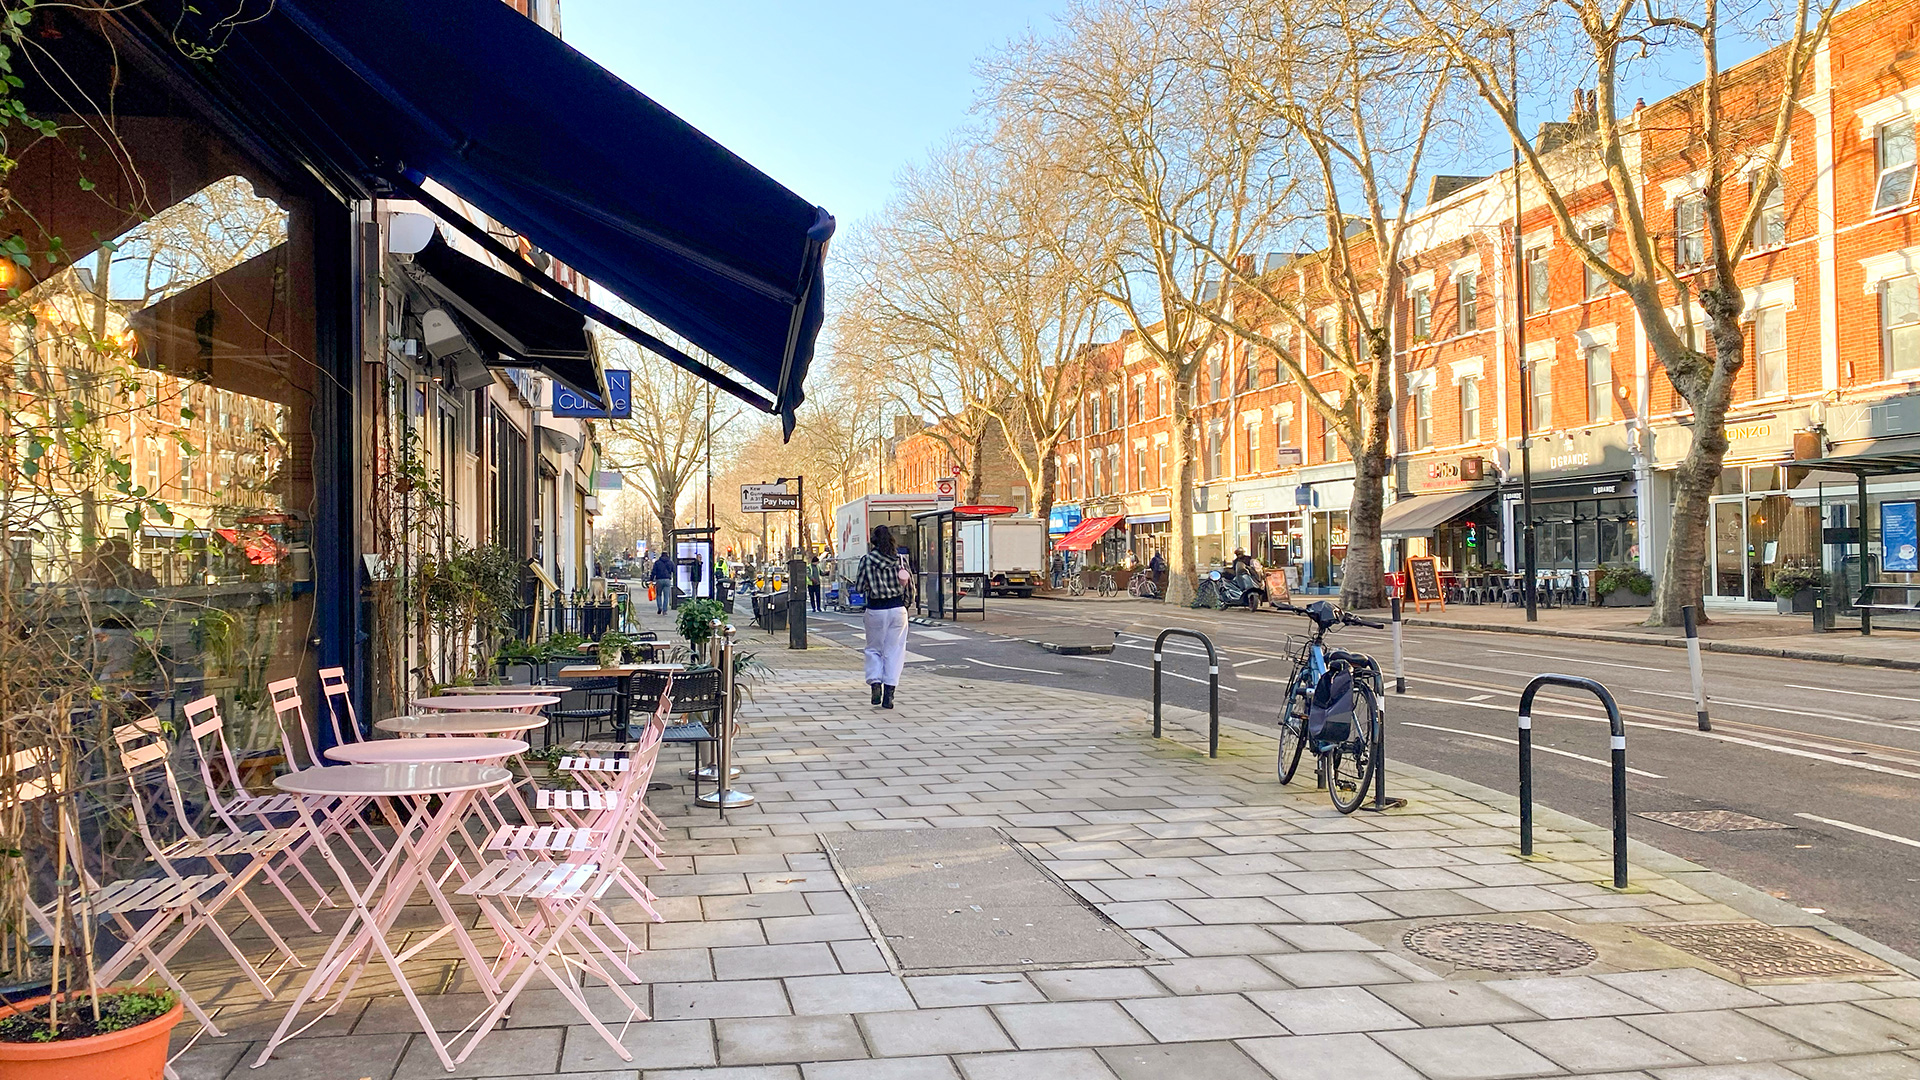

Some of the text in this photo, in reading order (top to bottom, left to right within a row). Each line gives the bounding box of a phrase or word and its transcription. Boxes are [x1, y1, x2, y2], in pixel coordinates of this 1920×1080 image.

[1726, 425, 1770, 440] ONZO
[1557, 453, 1589, 467] GRANDE
[763, 498, 796, 506] Pay here
[1272, 534, 1289, 545] SALE
